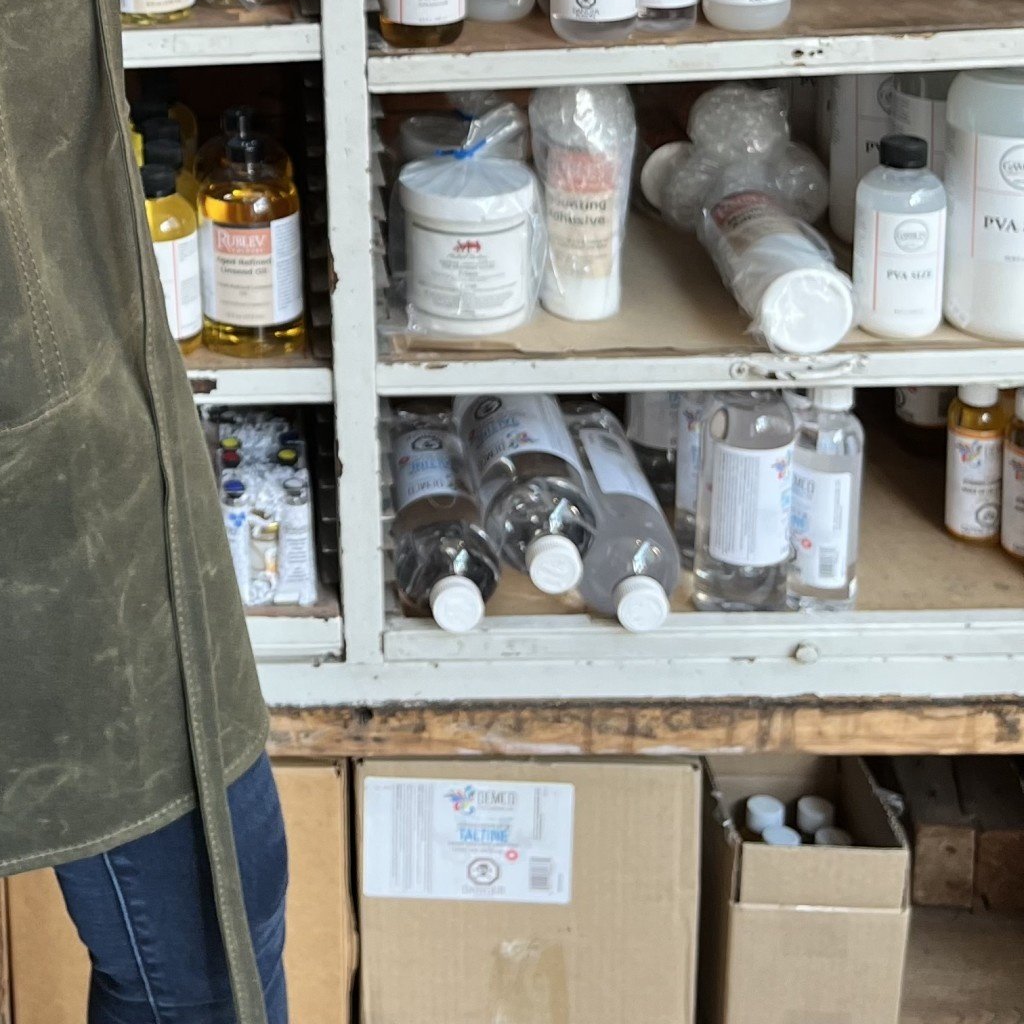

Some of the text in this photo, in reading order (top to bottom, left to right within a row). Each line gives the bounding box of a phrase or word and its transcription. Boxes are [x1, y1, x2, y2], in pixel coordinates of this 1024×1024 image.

[984, 215, 1019, 234] PVA
[217, 229, 265, 250] RUBLEV
[886, 270, 908, 280] PVA
